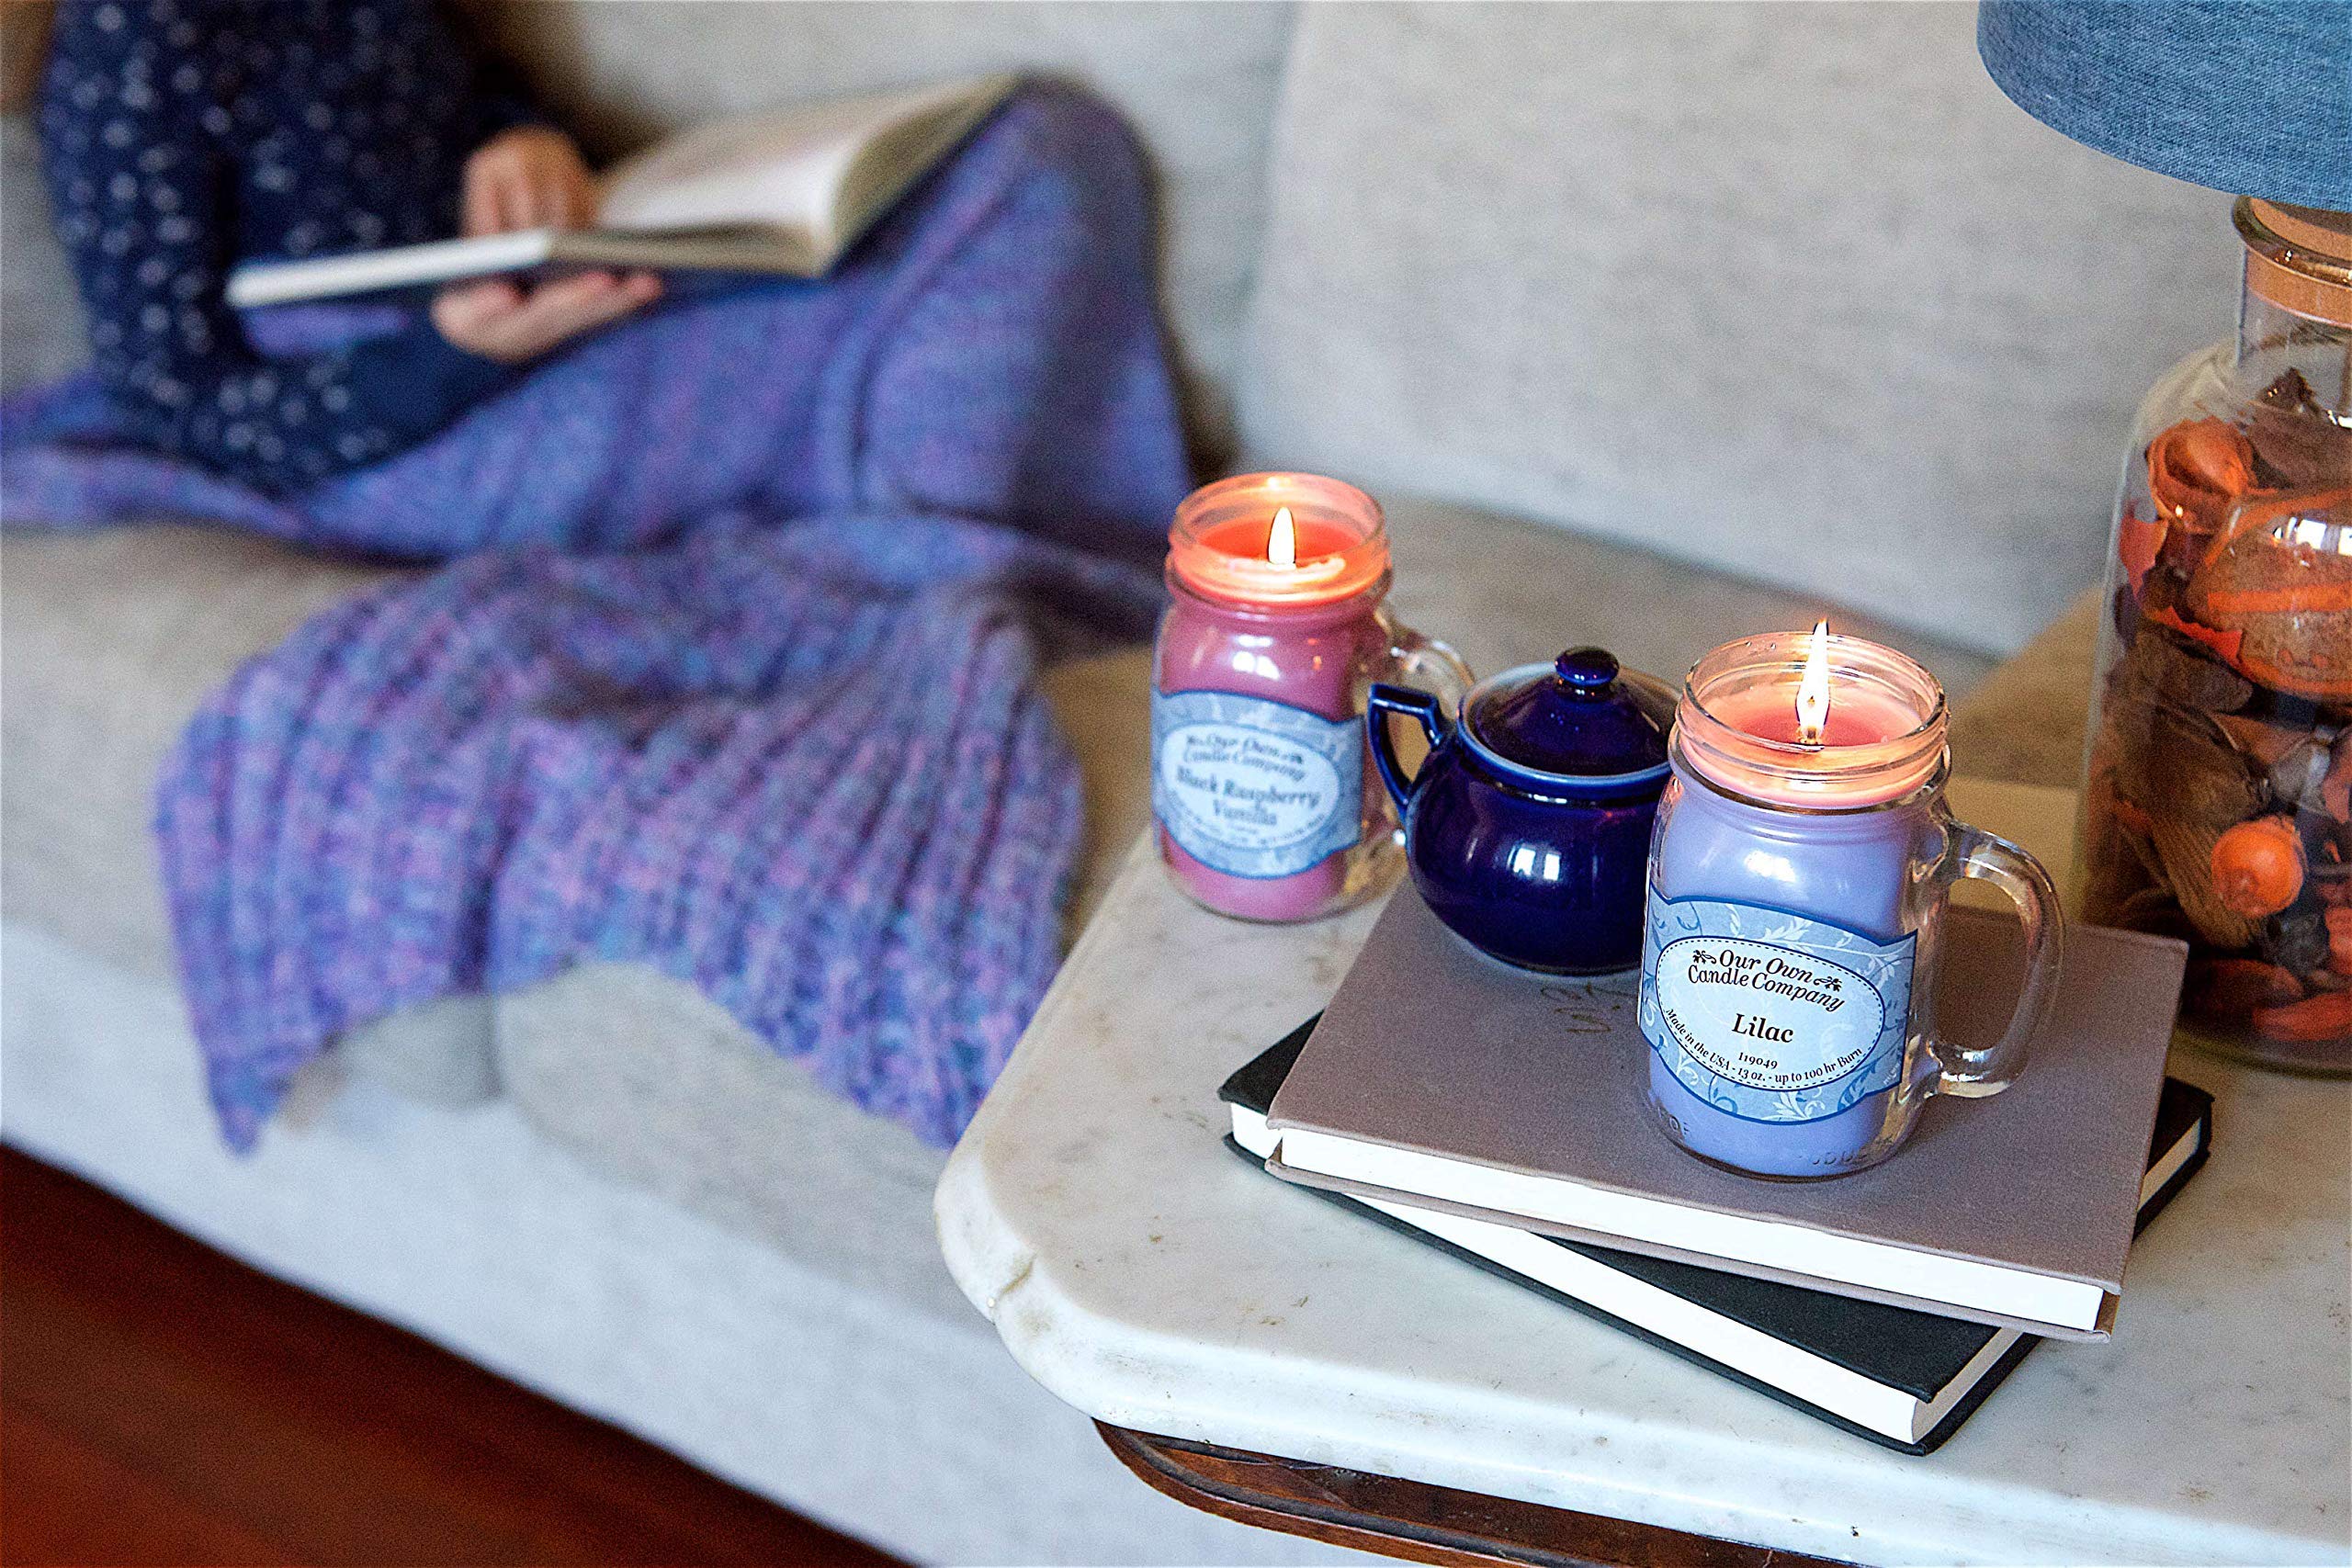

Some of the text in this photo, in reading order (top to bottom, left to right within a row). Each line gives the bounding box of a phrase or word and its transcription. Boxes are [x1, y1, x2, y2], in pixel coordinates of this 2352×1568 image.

[1177, 764, 1322, 809] Black Raspberry
[1212, 798, 1278, 825] Vanilla
[1719, 949, 1813, 984] Our Own
[1688, 964, 1846, 1012] Candle Company
[1731, 1012, 1793, 1043] Lilac
[1665, 1008, 1687, 1034] Made
[1684, 1032, 1696, 1045] in
[1693, 1041, 1710, 1058] the
[1708, 1052, 1731, 1071] USA
[1737, 1066, 1750, 1080] 13
[1750, 1070, 1766, 1082] oz.
[1774, 1073, 1789, 1086] up
[1791, 1071, 1803, 1083] to
[1804, 1066, 1824, 1080] 100
[1823, 1062, 1837, 1075] hr
[1837, 1047, 1863, 1068] Burn
[1737, 1051, 1779, 1070] 119049
